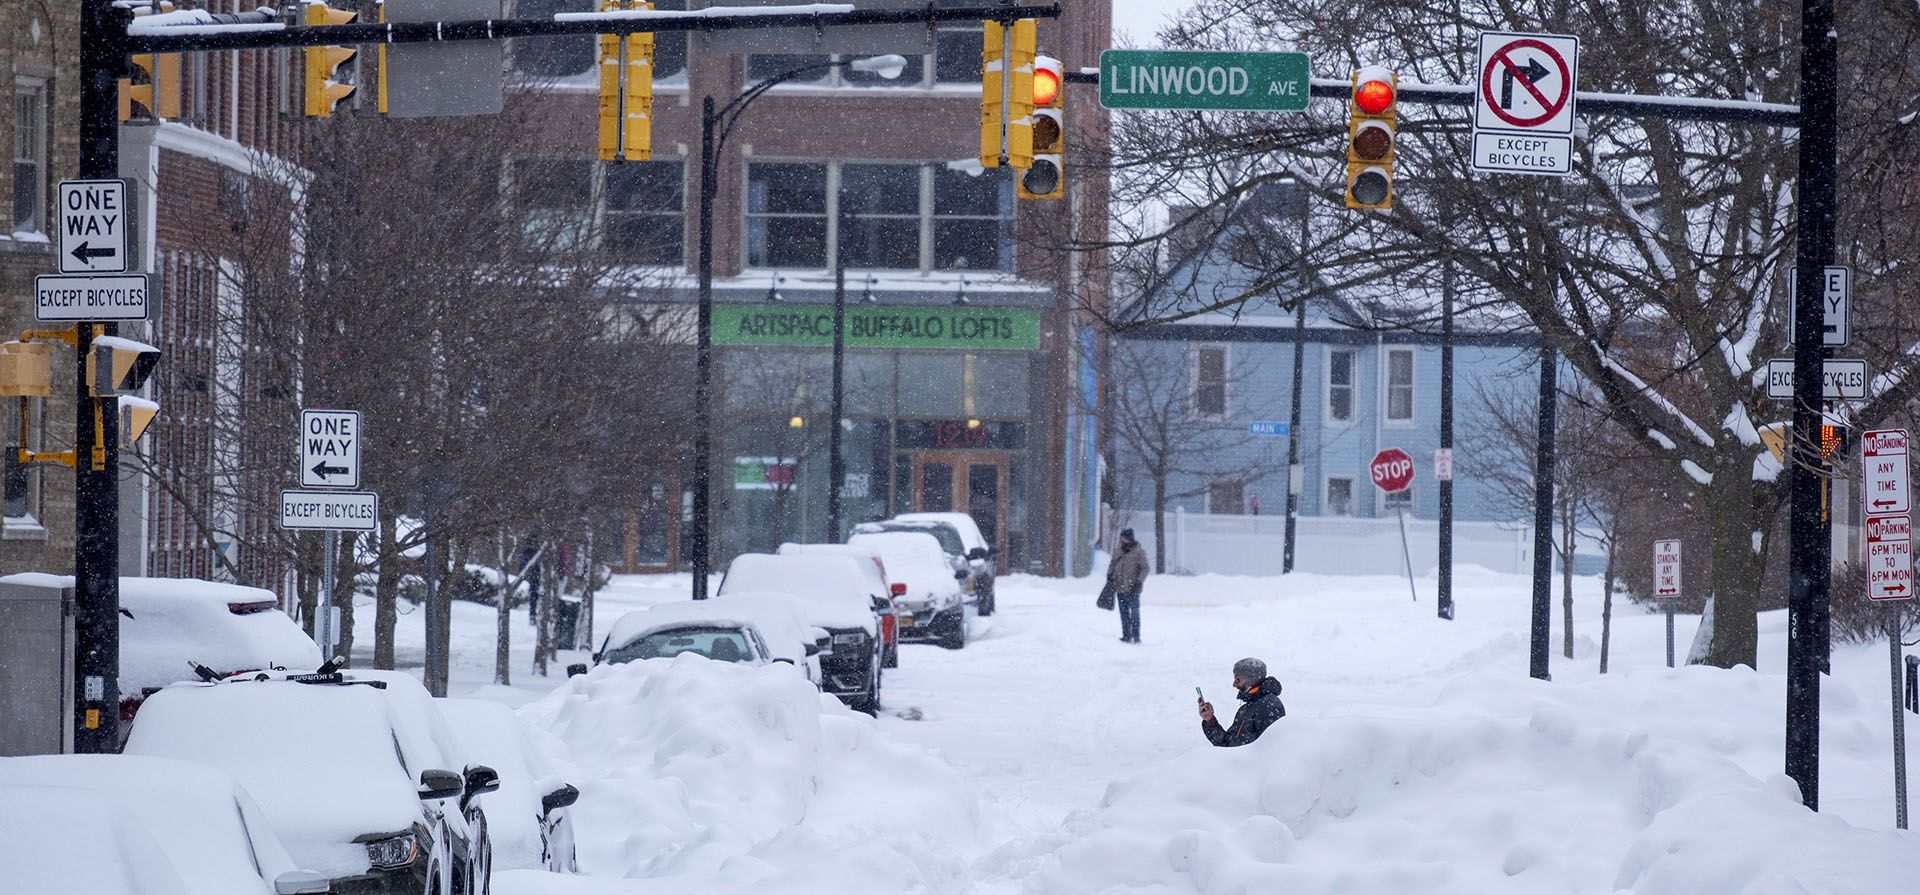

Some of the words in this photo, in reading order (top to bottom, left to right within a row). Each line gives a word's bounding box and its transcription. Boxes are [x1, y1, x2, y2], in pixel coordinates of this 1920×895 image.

[1111, 65, 1249, 96] LINWOOD
[1268, 81, 1298, 96] AVE
[1498, 138, 1548, 152] EXCEPT
[1489, 153, 1556, 167] BICYCLES
[68, 189, 116, 210] ONE
[67, 215, 117, 236] WAY
[40, 290, 82, 307] EXCEPT
[87, 289, 143, 306] BICYCLES
[738, 313, 833, 336] ARTSPAC
[852, 315, 943, 339] BUFFALO
[951, 316, 1013, 340] LOFTS
[310, 417, 351, 435] ONE
[1252, 424, 1275, 433] MAIN
[309, 438, 351, 456] WAY
[1864, 437, 1877, 453] NO
[1877, 438, 1906, 449] STANDING
[1374, 459, 1411, 481] STOP
[1878, 463, 1895, 474] ANY
[1877, 480, 1896, 491] TIME
[285, 503, 321, 517] EXCEPT
[325, 504, 373, 518] BICYCLES
[1867, 522, 1880, 538] NO
[1881, 523, 1909, 535] PARKING
[1664, 543, 1671, 552] NO
[1871, 544, 1889, 556] 6PM
[1891, 544, 1908, 554] THU
[1657, 553, 1678, 563] STANDING
[1885, 557, 1895, 568] TO
[1663, 565, 1672, 575] ANY
[1871, 570, 1889, 581] 6PM
[1891, 569, 1910, 581] MON
[1662, 576, 1673, 585] TIME
